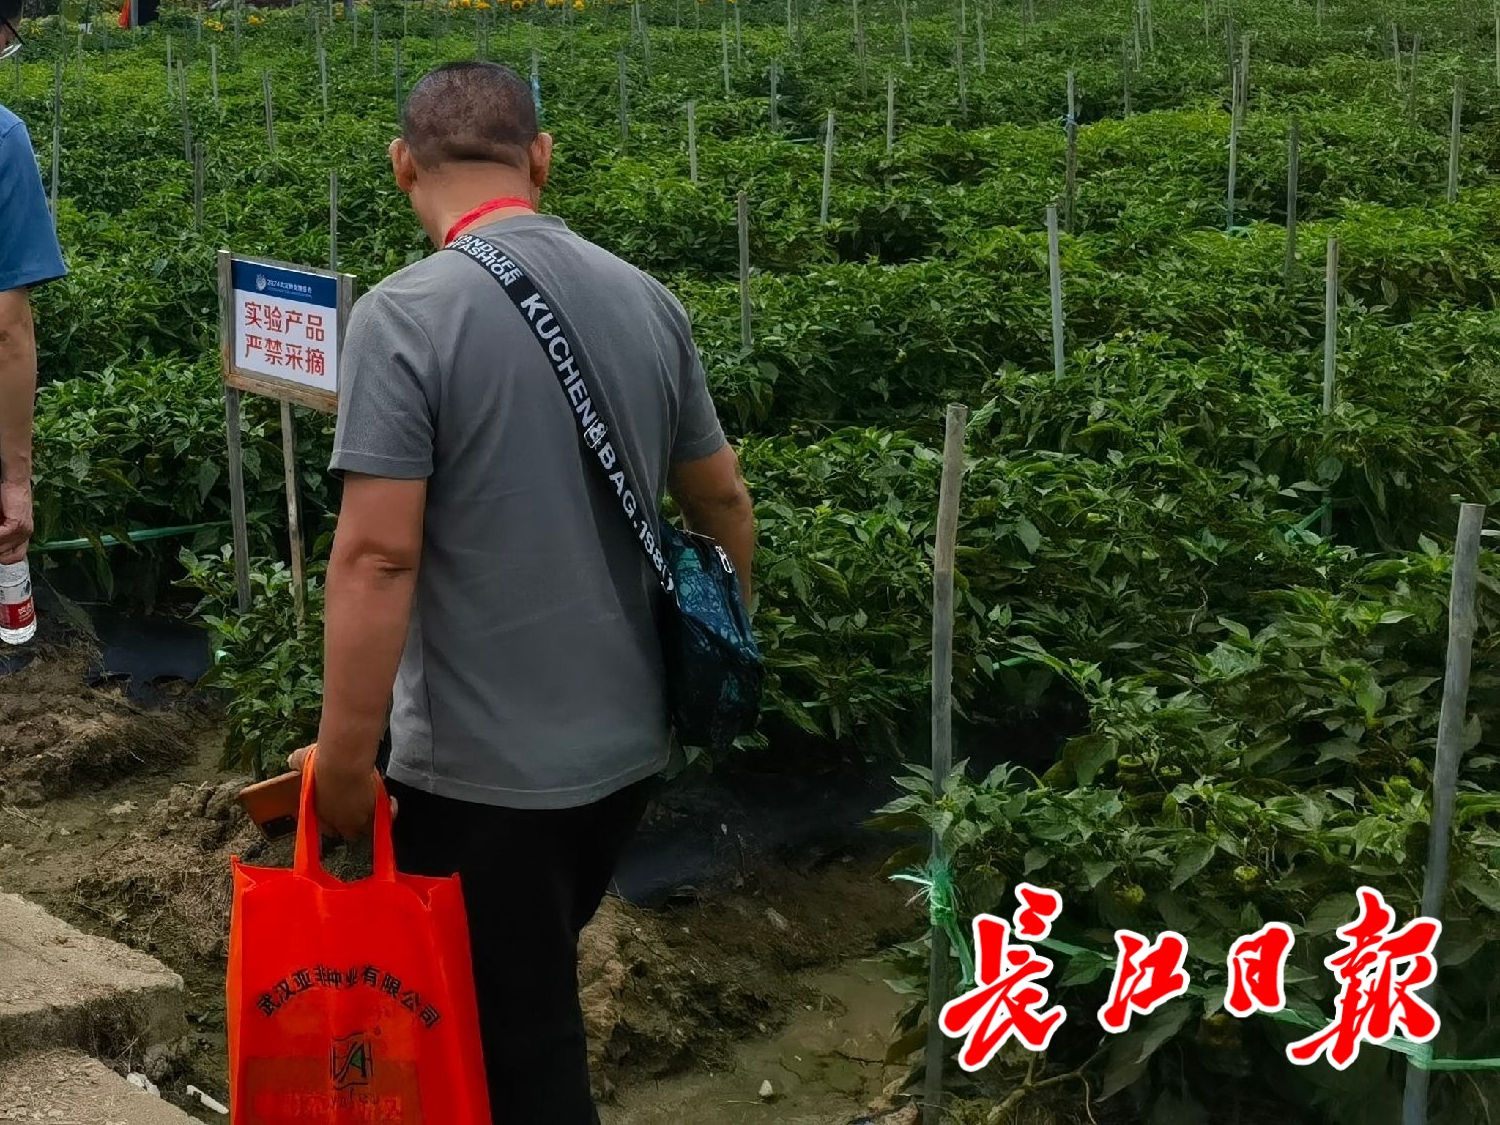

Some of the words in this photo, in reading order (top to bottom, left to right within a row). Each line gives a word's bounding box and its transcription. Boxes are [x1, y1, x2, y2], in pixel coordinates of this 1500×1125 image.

[244, 301, 325, 342] 实验产品
[244, 333, 325, 376] 严禁采摘
[257, 964, 441, 1030] 武汉亚非种业有限公司
